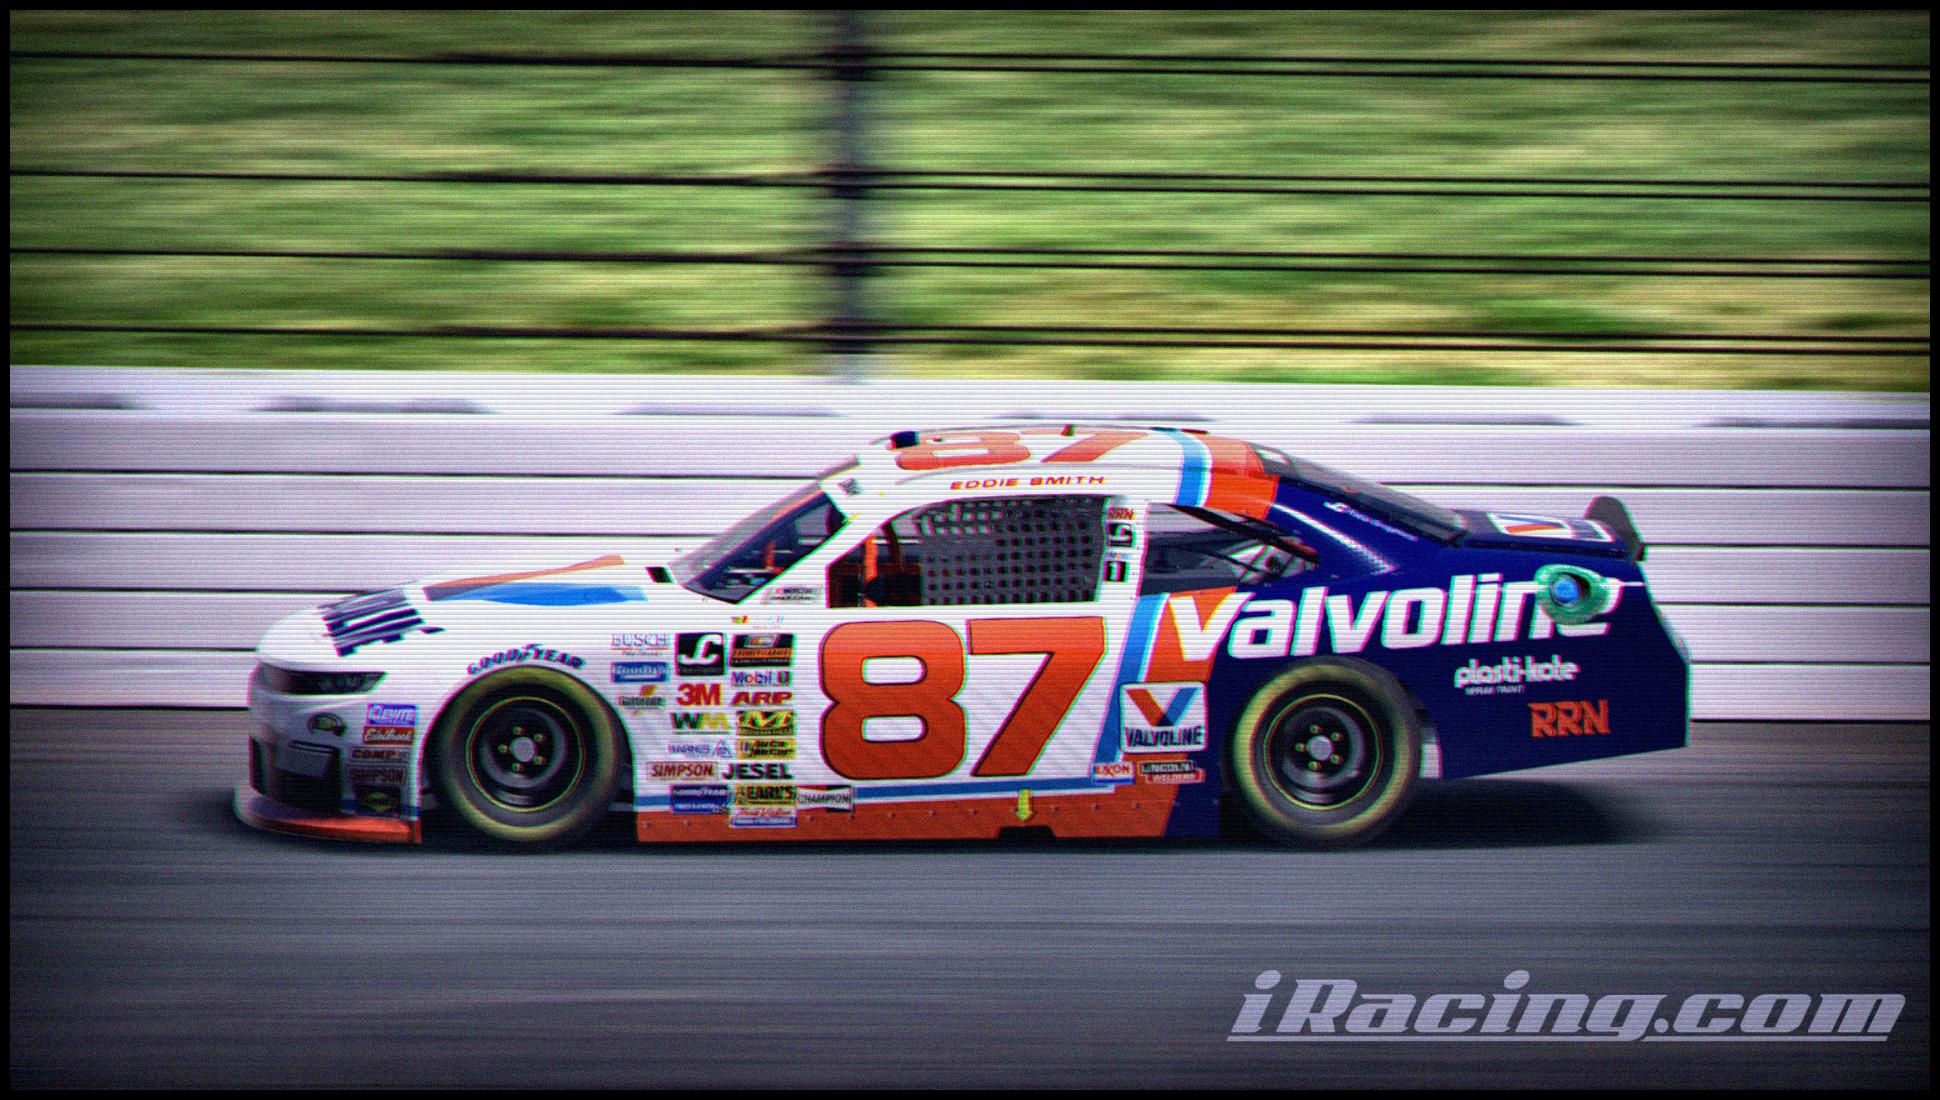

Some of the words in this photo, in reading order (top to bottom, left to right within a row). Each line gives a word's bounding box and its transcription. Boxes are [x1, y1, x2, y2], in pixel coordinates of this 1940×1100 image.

[892, 430, 1148, 471] 87
[949, 480, 1020, 491] EDDIE
[1029, 475, 1105, 487] SMITH
[467, 643, 586, 676] GOODYEAR
[731, 671, 774, 686] Mobil
[1454, 654, 1581, 689] plasti-kote
[677, 683, 722, 706] 3M
[731, 691, 794, 706] ARP
[818, 616, 1108, 780] 87
[1527, 699, 1611, 738] RRN
[1125, 725, 1205, 748] VALVOLINE
[651, 763, 714, 777] SIMPSON
[722, 763, 793, 780] JESEL
[797, 792, 850, 806] CHAMPION
